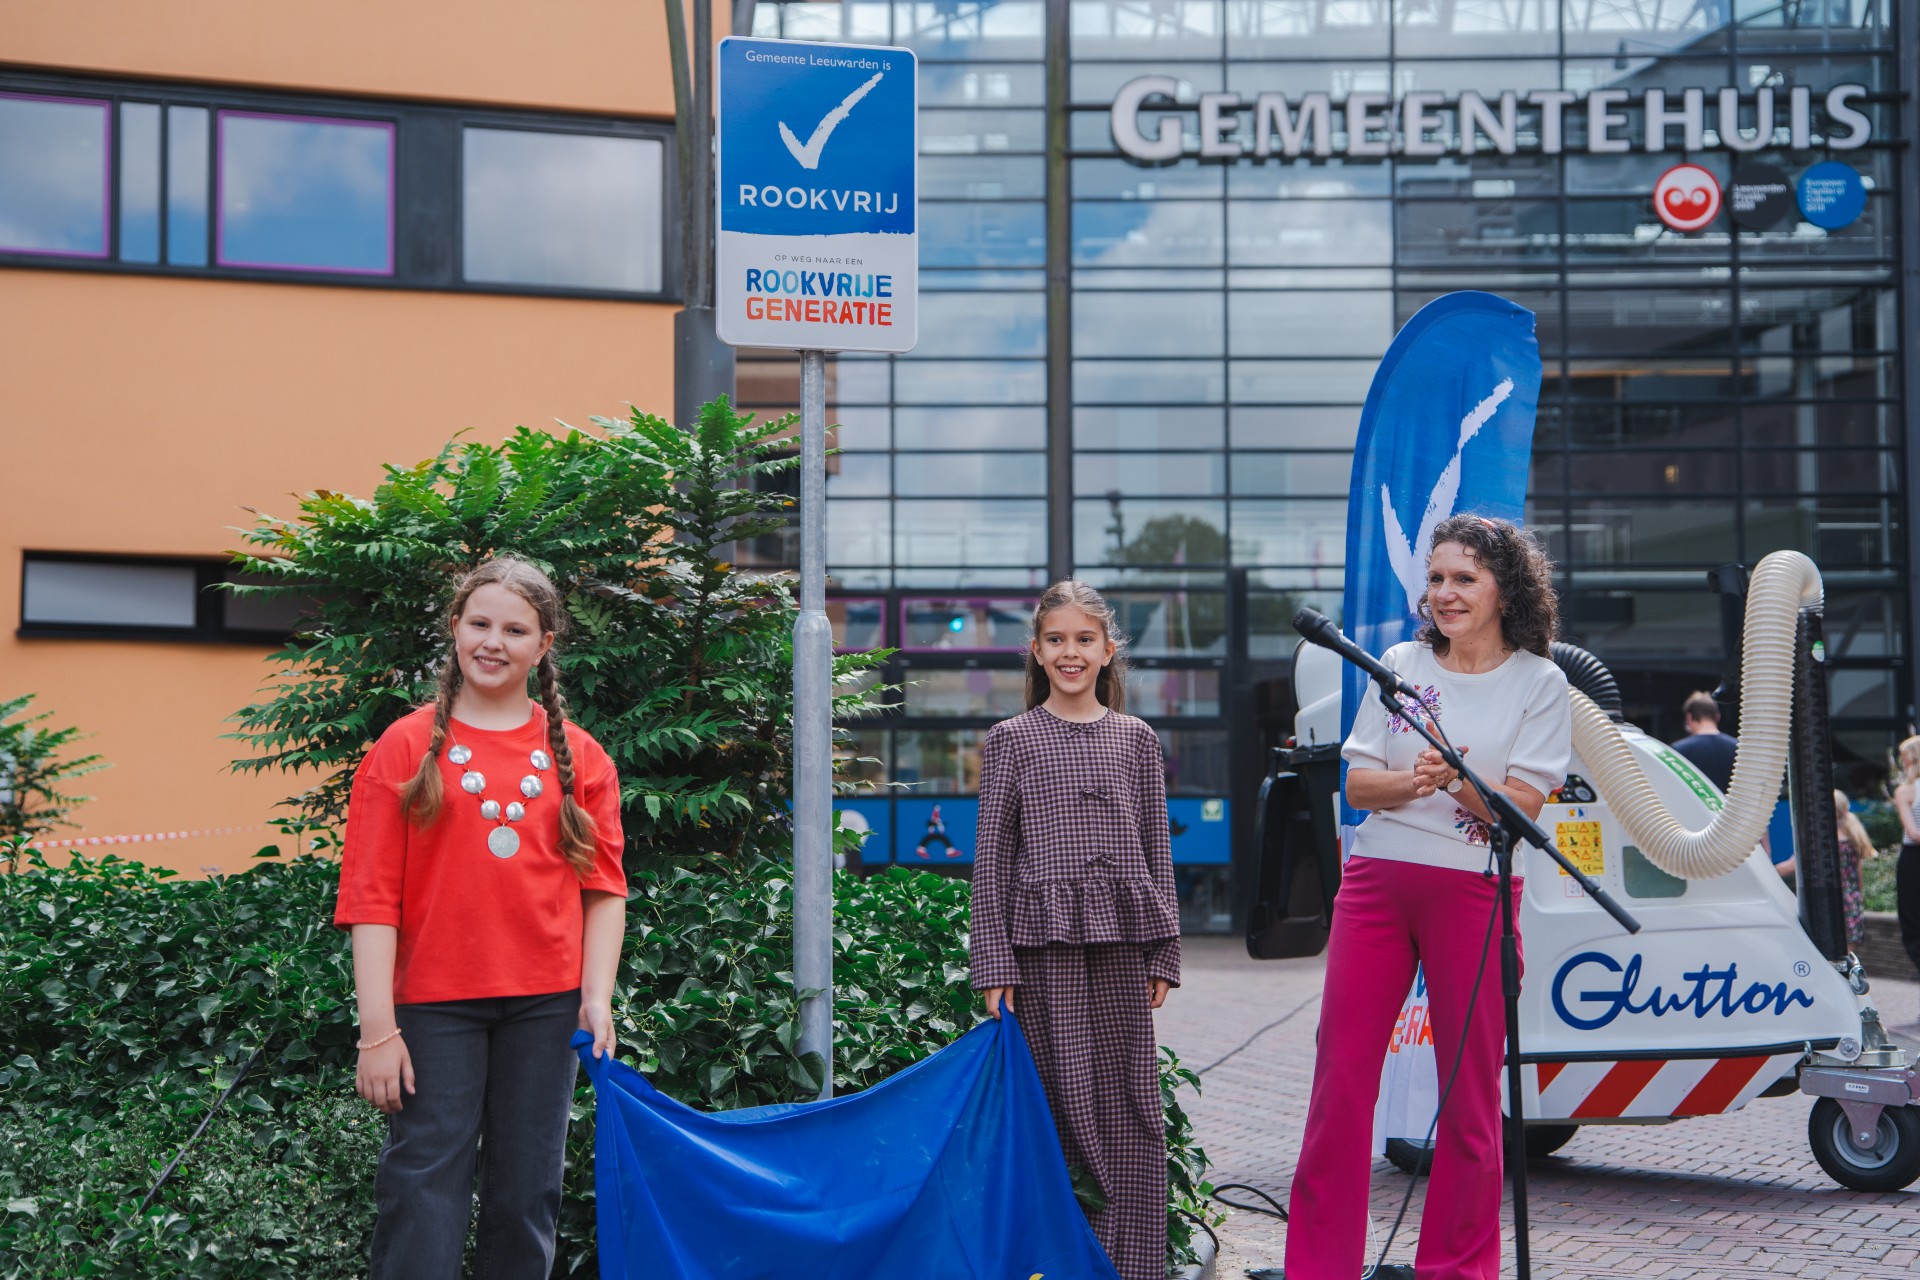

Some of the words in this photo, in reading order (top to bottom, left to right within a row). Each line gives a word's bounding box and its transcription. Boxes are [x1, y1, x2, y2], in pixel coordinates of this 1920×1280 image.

[745, 50, 806, 65] Gemeente
[809, 54, 879, 70] Leeuwarden
[882, 59, 891, 70] is
[1111, 76, 1873, 160] GEMEENTEHUIS
[739, 184, 899, 214] ROOKVRIJ
[774, 254, 787, 262] OP
[791, 255, 812, 263] WEG
[815, 256, 842, 265] NAAR
[845, 258, 863, 266] EEN
[746, 268, 893, 299] ROOKVRIJE
[746, 296, 893, 326] GENERATIE
[1551, 951, 1814, 1031] Glutton
